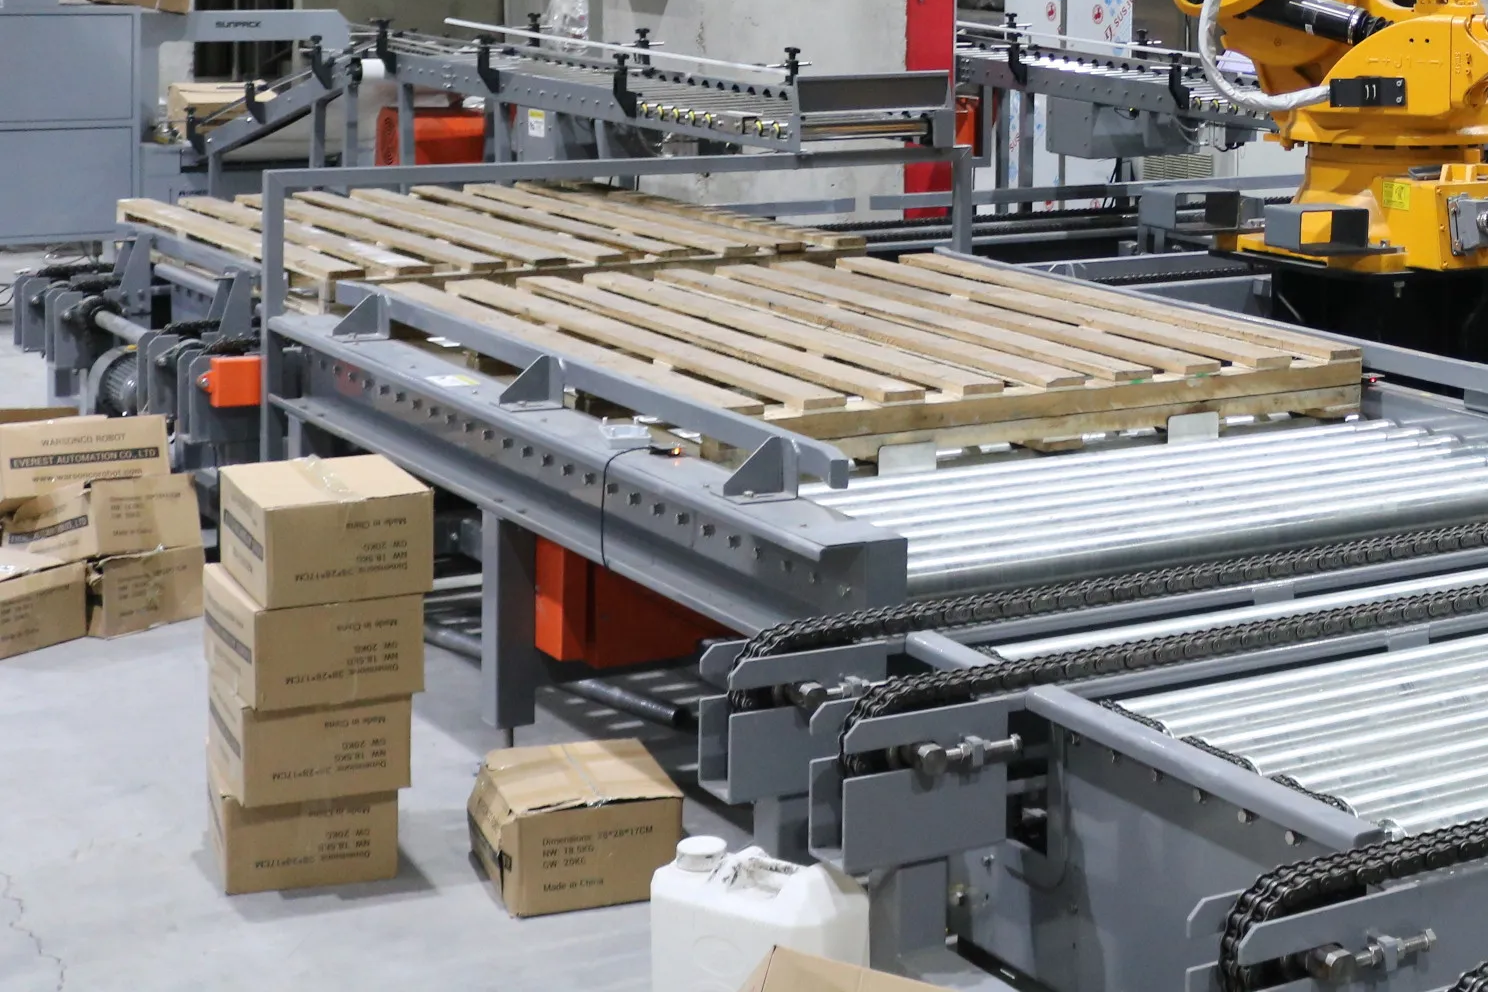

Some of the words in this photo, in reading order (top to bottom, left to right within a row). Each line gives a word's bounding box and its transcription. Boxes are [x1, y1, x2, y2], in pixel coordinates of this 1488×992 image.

[1114, 7, 1127, 27] SUS
[41, 435, 93, 447] WARSONCO
[95, 433, 126, 443] ROBOT
[13, 456, 56, 468] EVEREST
[56, 451, 118, 465] AUTOMATION
[138, 448, 157, 457] LTD
[32, 467, 143, 483] www.warsoncorobot.com
[386, 517, 407, 526] Made
[375, 619, 398, 628] Made
[351, 718, 360, 726] in
[362, 716, 386, 725] Made
[543, 882, 566, 892] Made
[569, 881, 577, 889] in
[580, 878, 604, 888] China
